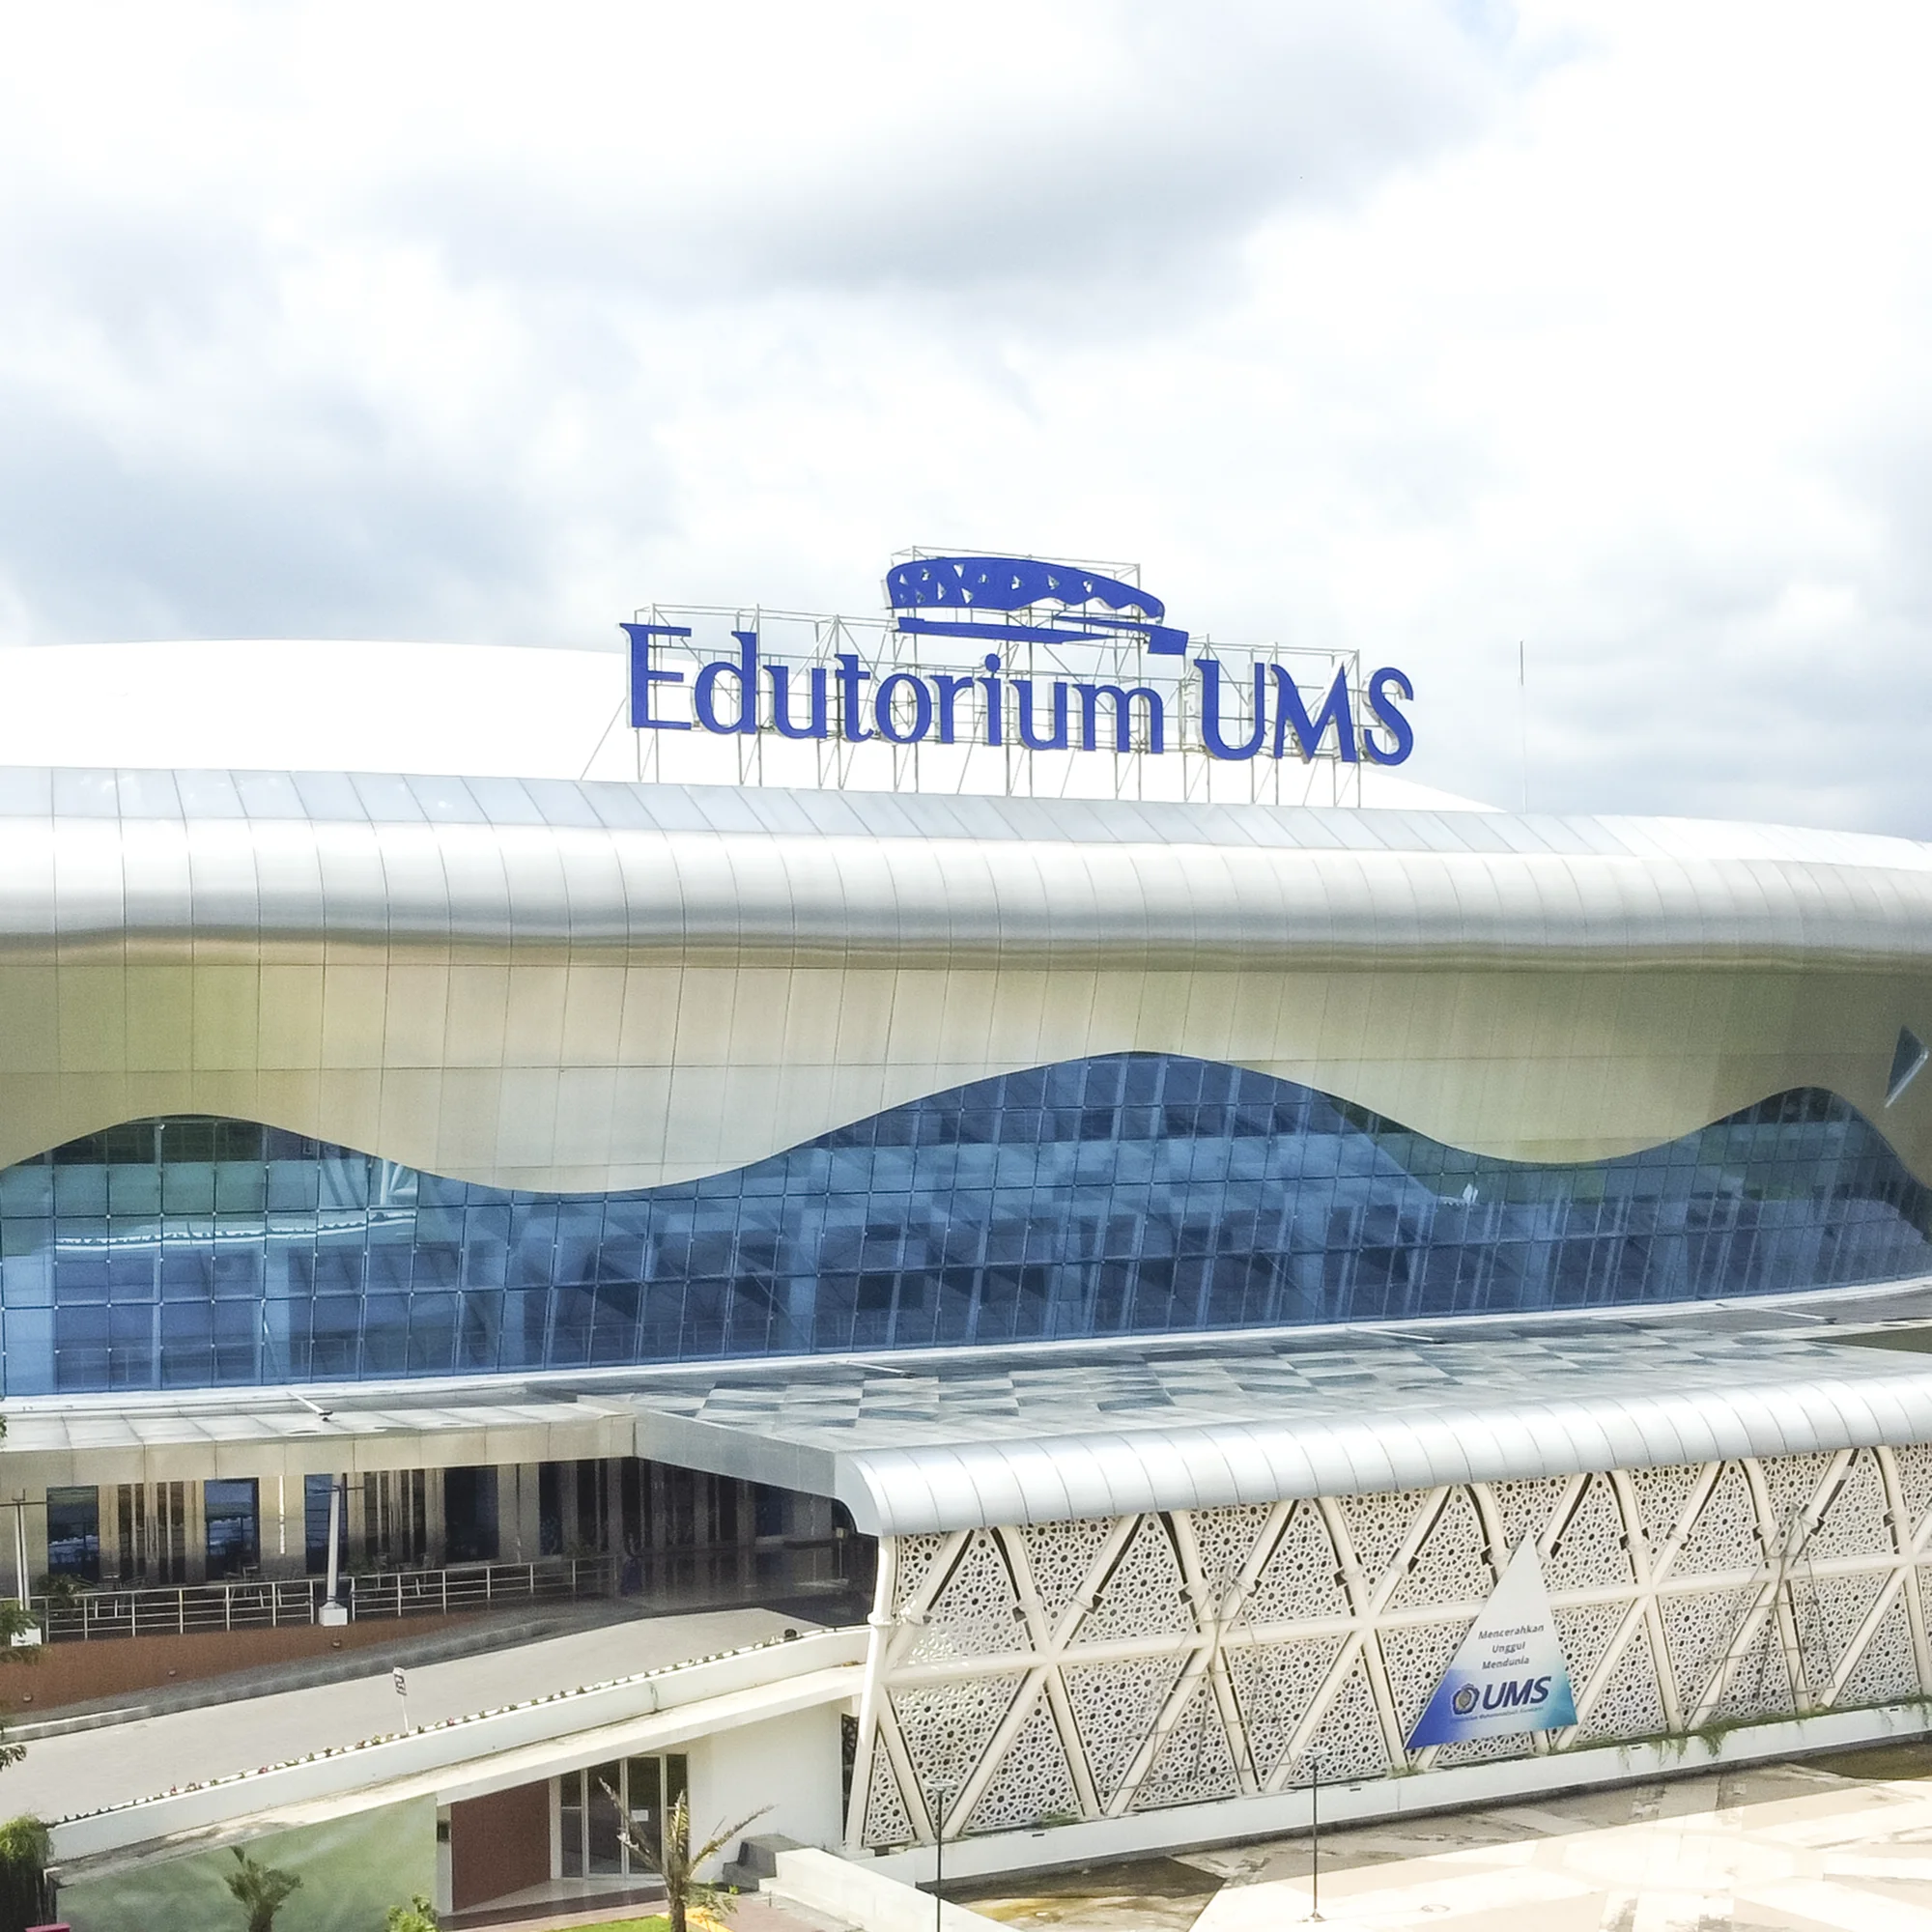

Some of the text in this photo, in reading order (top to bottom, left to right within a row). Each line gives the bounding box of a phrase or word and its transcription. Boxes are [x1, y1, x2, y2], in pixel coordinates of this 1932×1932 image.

[619, 623, 1414, 766] Edutorium UMS
[1478, 1624, 1544, 1639] Mencerahkan
[1492, 1641, 1525, 1654] Unggul
[1482, 1656, 1529, 1669] Mendunia
[1483, 1676, 1551, 1710] UMS
